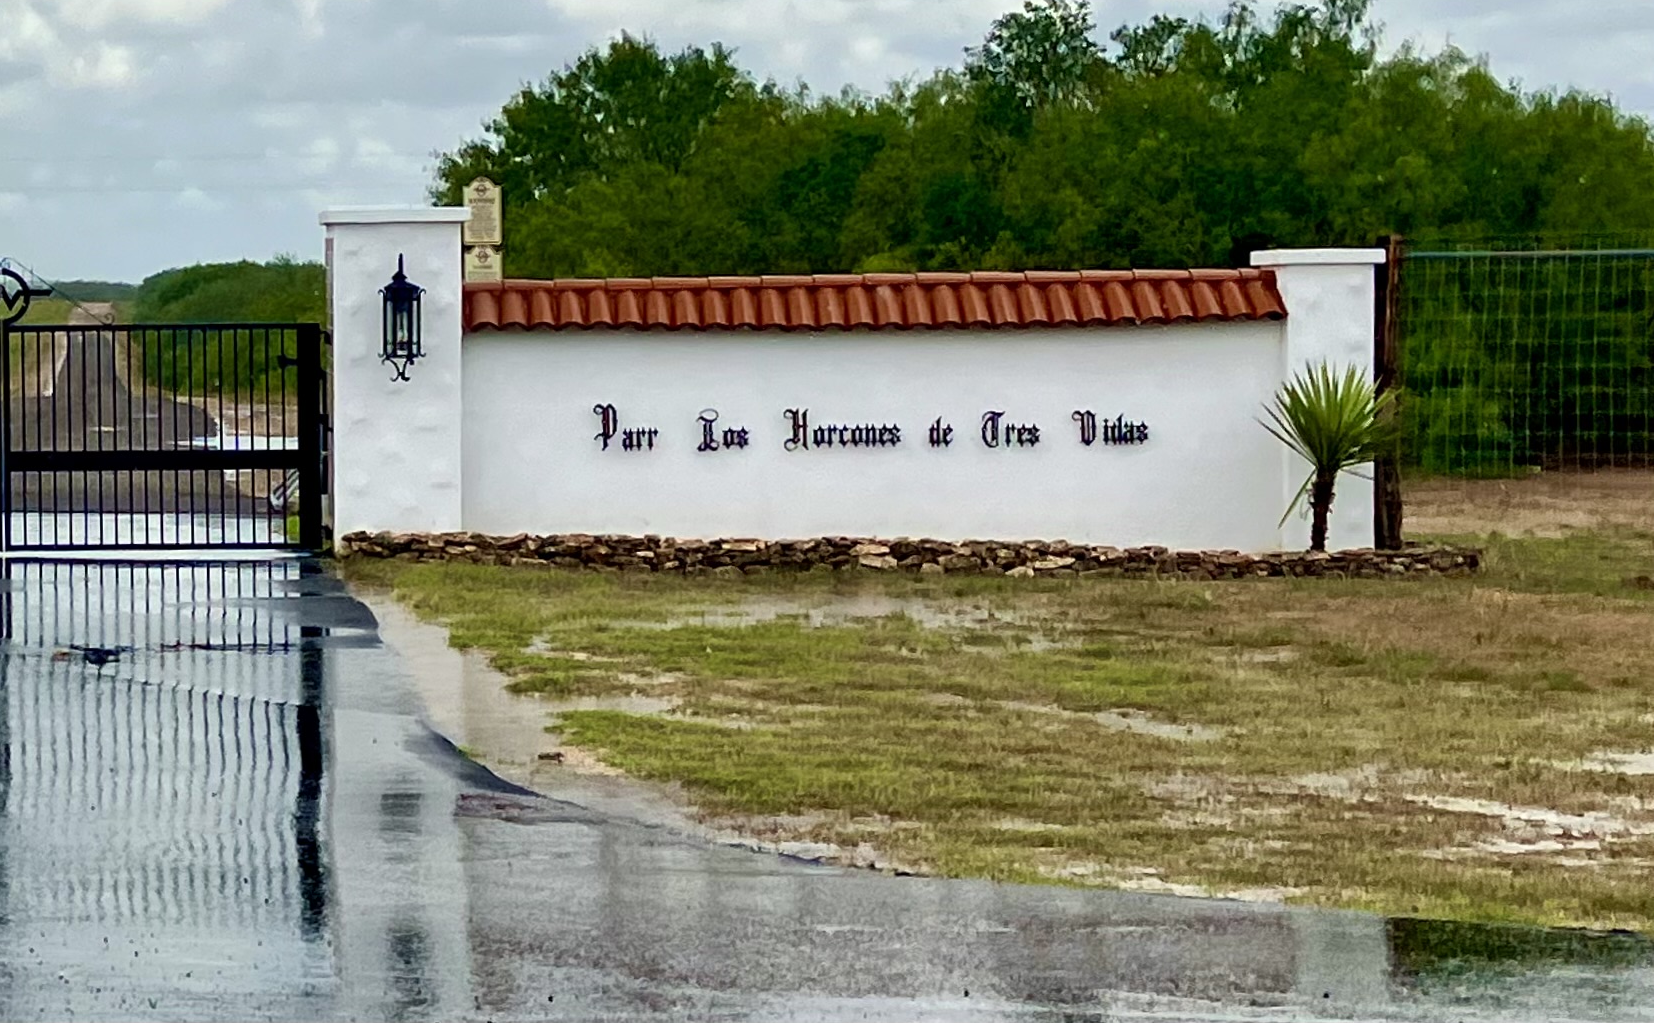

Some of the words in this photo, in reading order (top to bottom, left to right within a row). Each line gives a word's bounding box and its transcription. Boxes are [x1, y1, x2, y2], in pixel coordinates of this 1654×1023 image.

[592, 403, 659, 452] Parr
[696, 408, 750, 452] Los
[783, 408, 901, 452] Horcones
[928, 415, 954, 448] de
[981, 410, 1040, 448] Tres
[1071, 409, 1149, 447] Vidas
